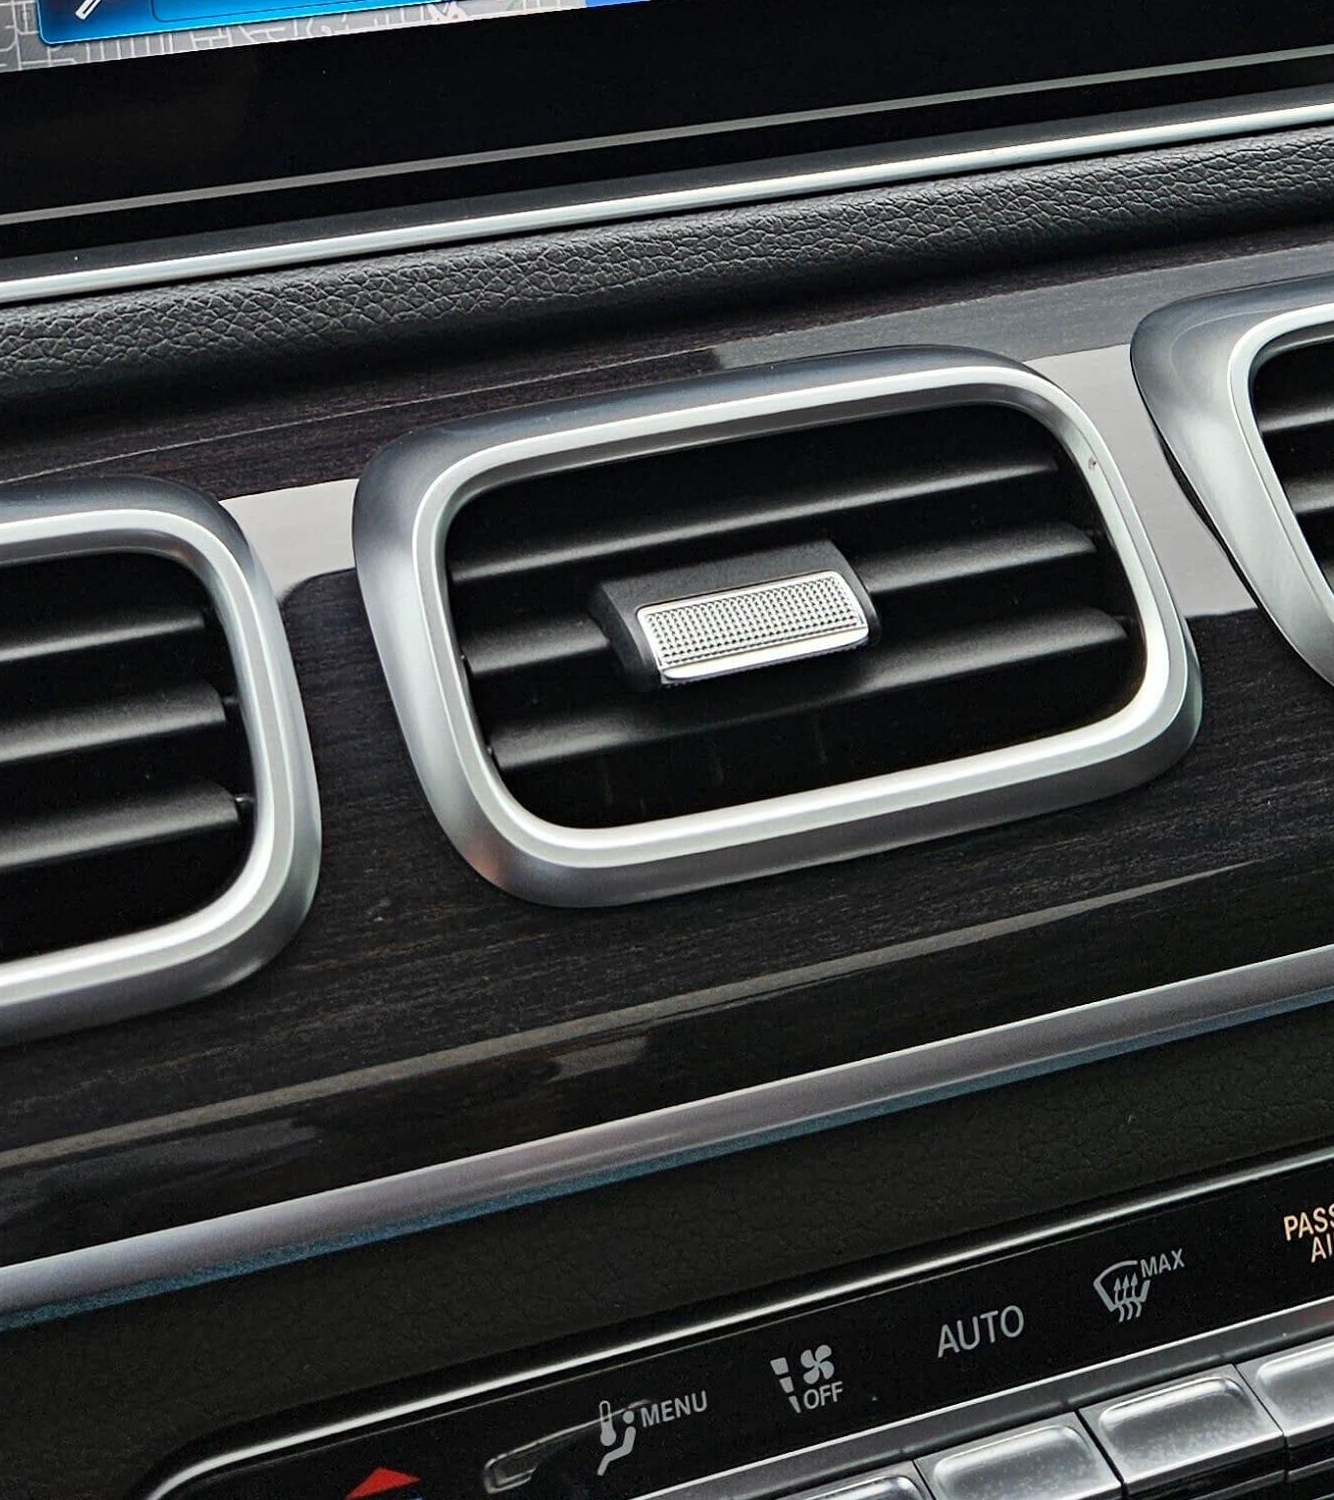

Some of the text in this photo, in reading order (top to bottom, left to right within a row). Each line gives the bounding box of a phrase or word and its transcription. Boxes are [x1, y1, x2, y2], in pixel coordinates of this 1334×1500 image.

[1140, 1248, 1185, 1278] MAX
[937, 1305, 1025, 1358] AUTO
[640, 1390, 709, 1428] MENU
[803, 1381, 844, 1410] OFF
